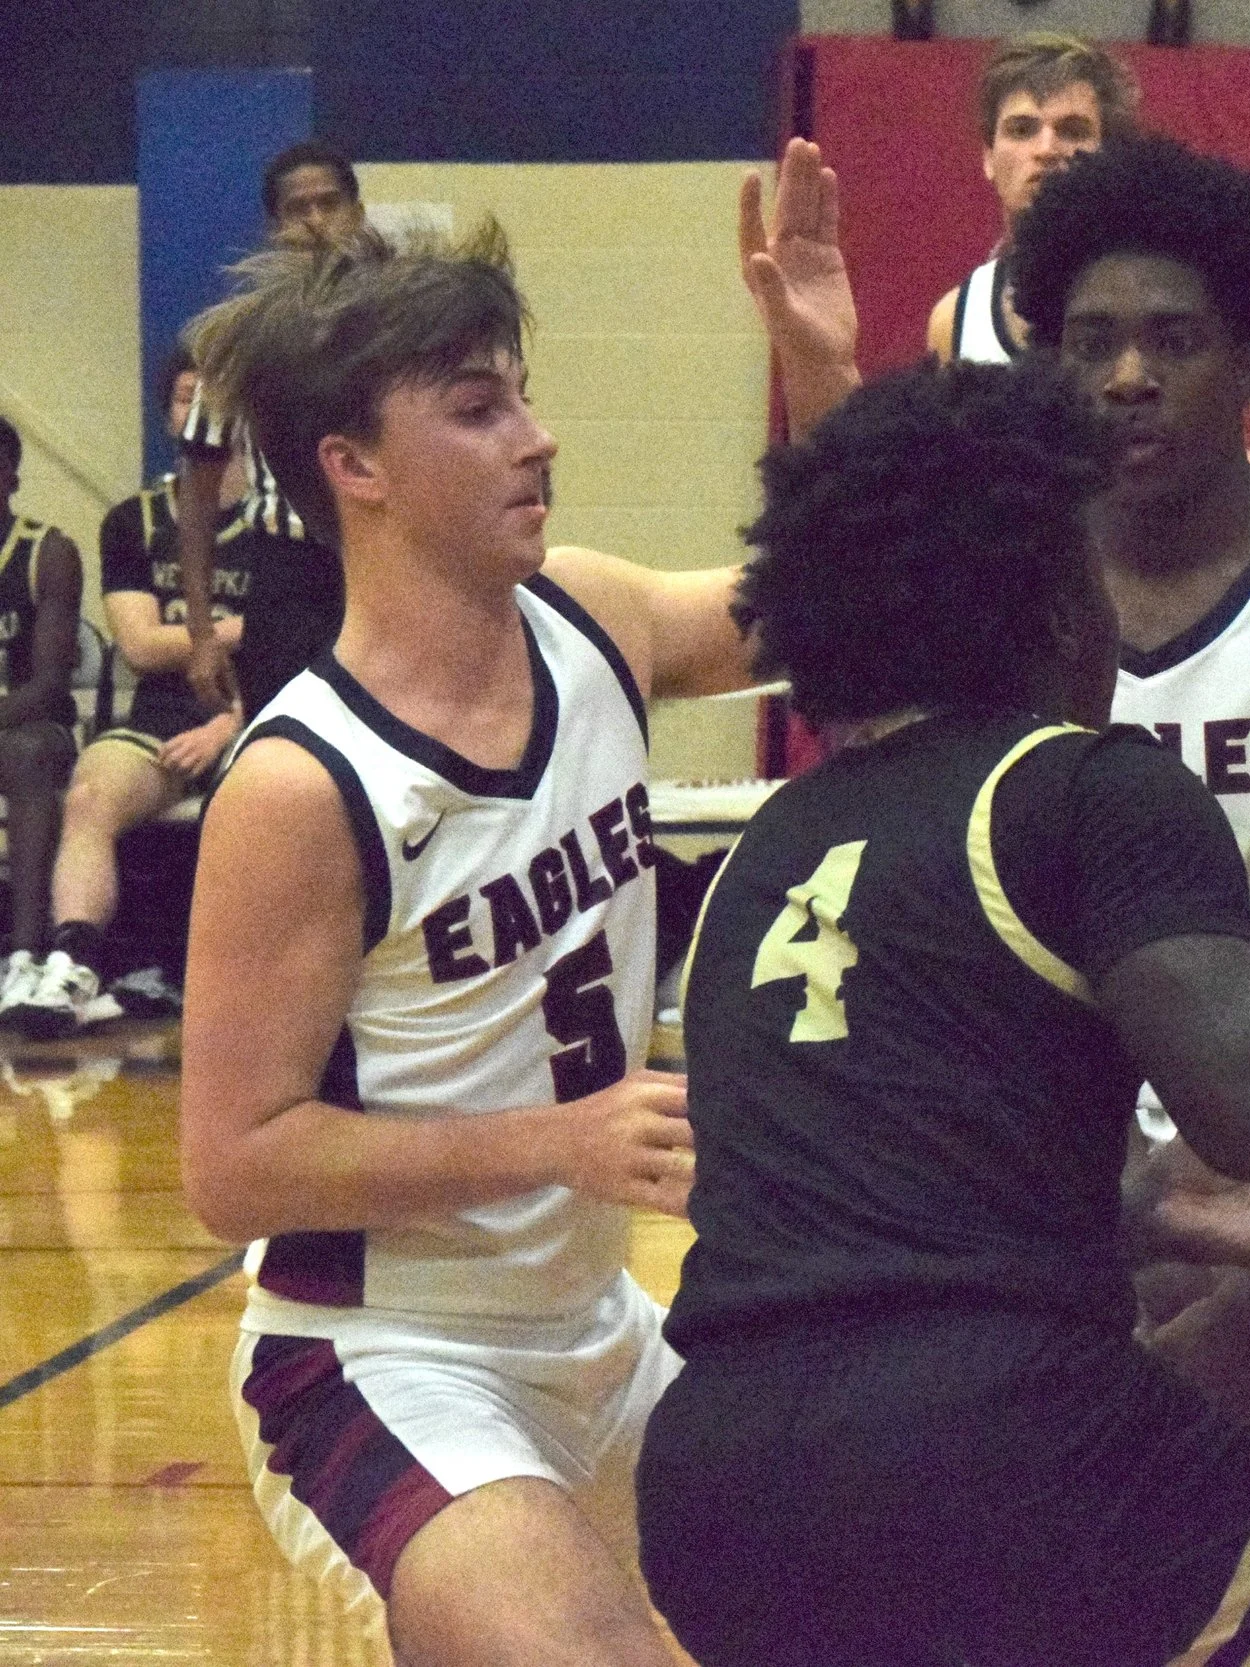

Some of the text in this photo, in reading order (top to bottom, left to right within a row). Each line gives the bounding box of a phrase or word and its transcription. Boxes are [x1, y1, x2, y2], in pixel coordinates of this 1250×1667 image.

[421, 782, 654, 984] EAGLES
[751, 840, 868, 1043] 4
[543, 929, 626, 1104] 5
